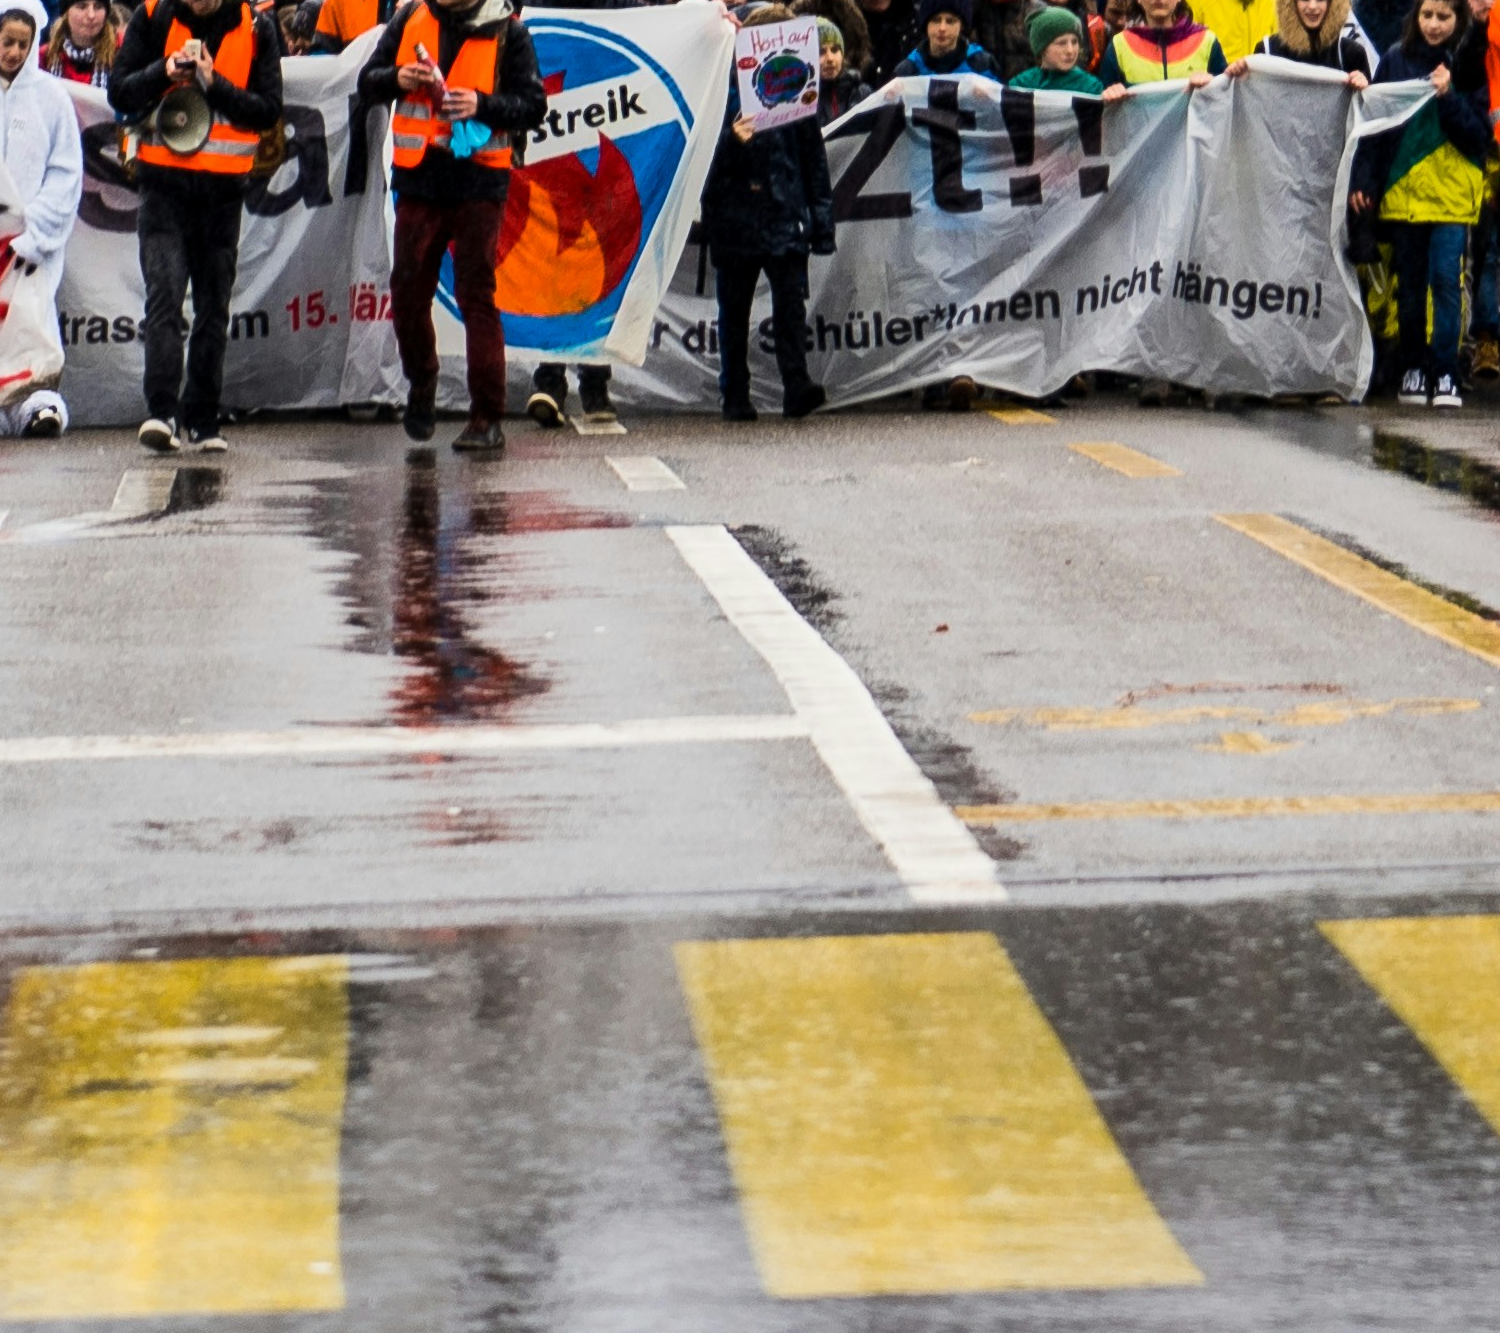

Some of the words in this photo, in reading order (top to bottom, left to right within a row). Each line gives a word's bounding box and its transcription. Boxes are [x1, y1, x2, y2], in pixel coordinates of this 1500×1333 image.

[286, 290, 338, 331] 15.
[1076, 260, 1164, 316] nicht
[1172, 260, 1323, 321] hängen!
